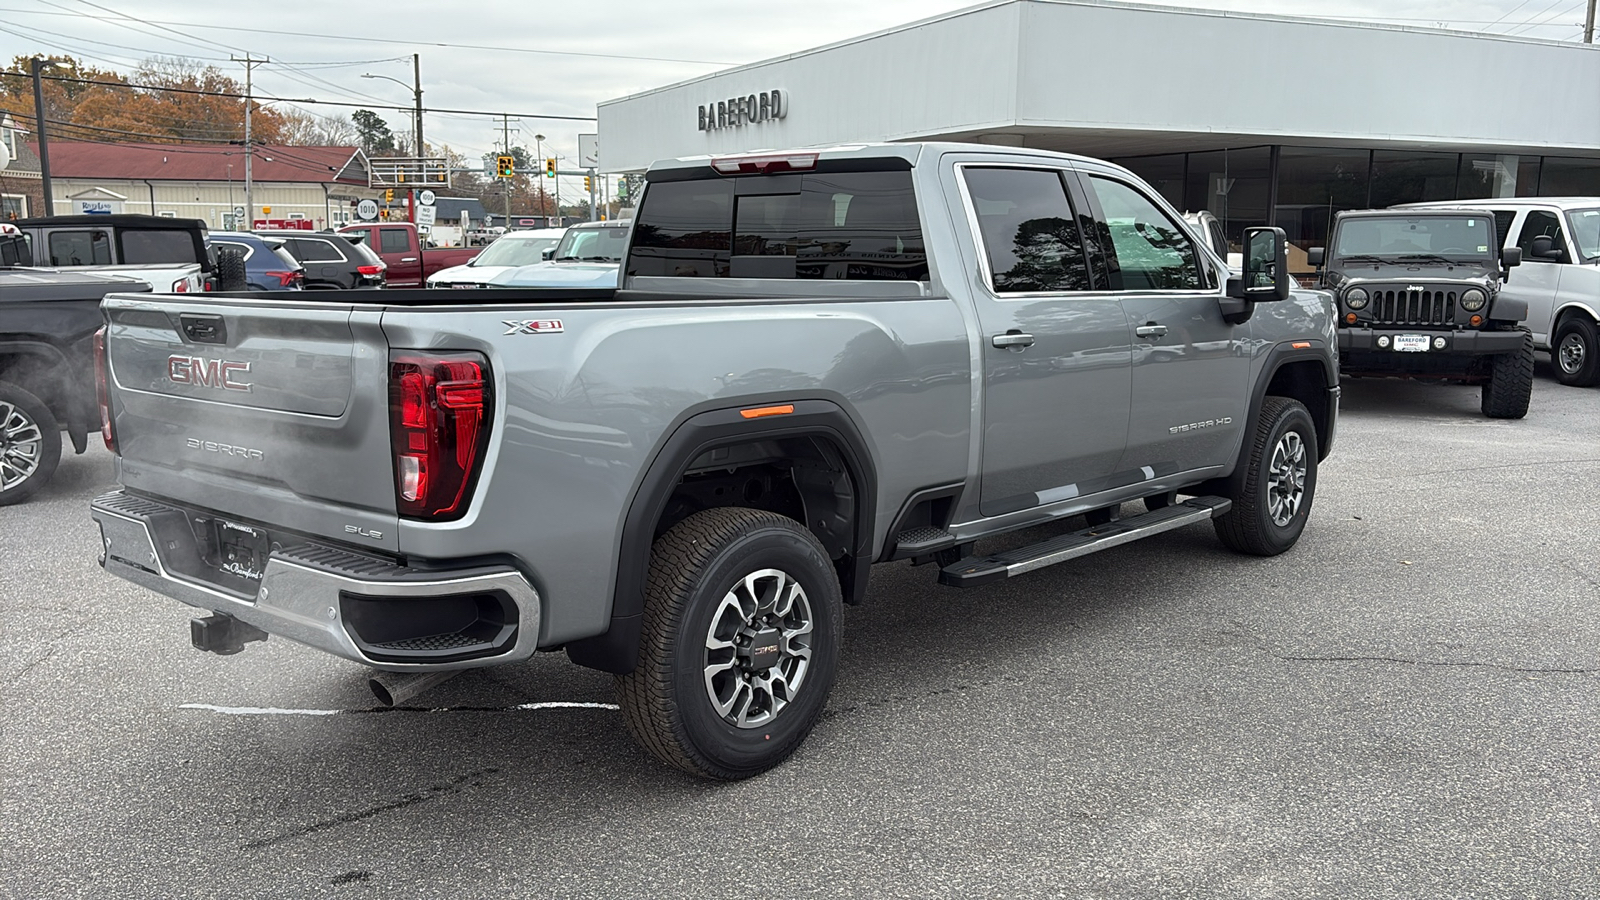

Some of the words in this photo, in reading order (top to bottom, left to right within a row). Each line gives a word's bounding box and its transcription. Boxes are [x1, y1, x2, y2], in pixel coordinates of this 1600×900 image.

[698, 90, 788, 132] BAREFORD
[359, 205, 376, 214] 1010
[501, 319, 565, 335] X31
[168, 354, 253, 392] GMC
[1169, 420, 1214, 434] SIERRA
[1215, 417, 1232, 426] HD
[186, 437, 265, 460] SIERRA
[344, 524, 383, 540] SLE
